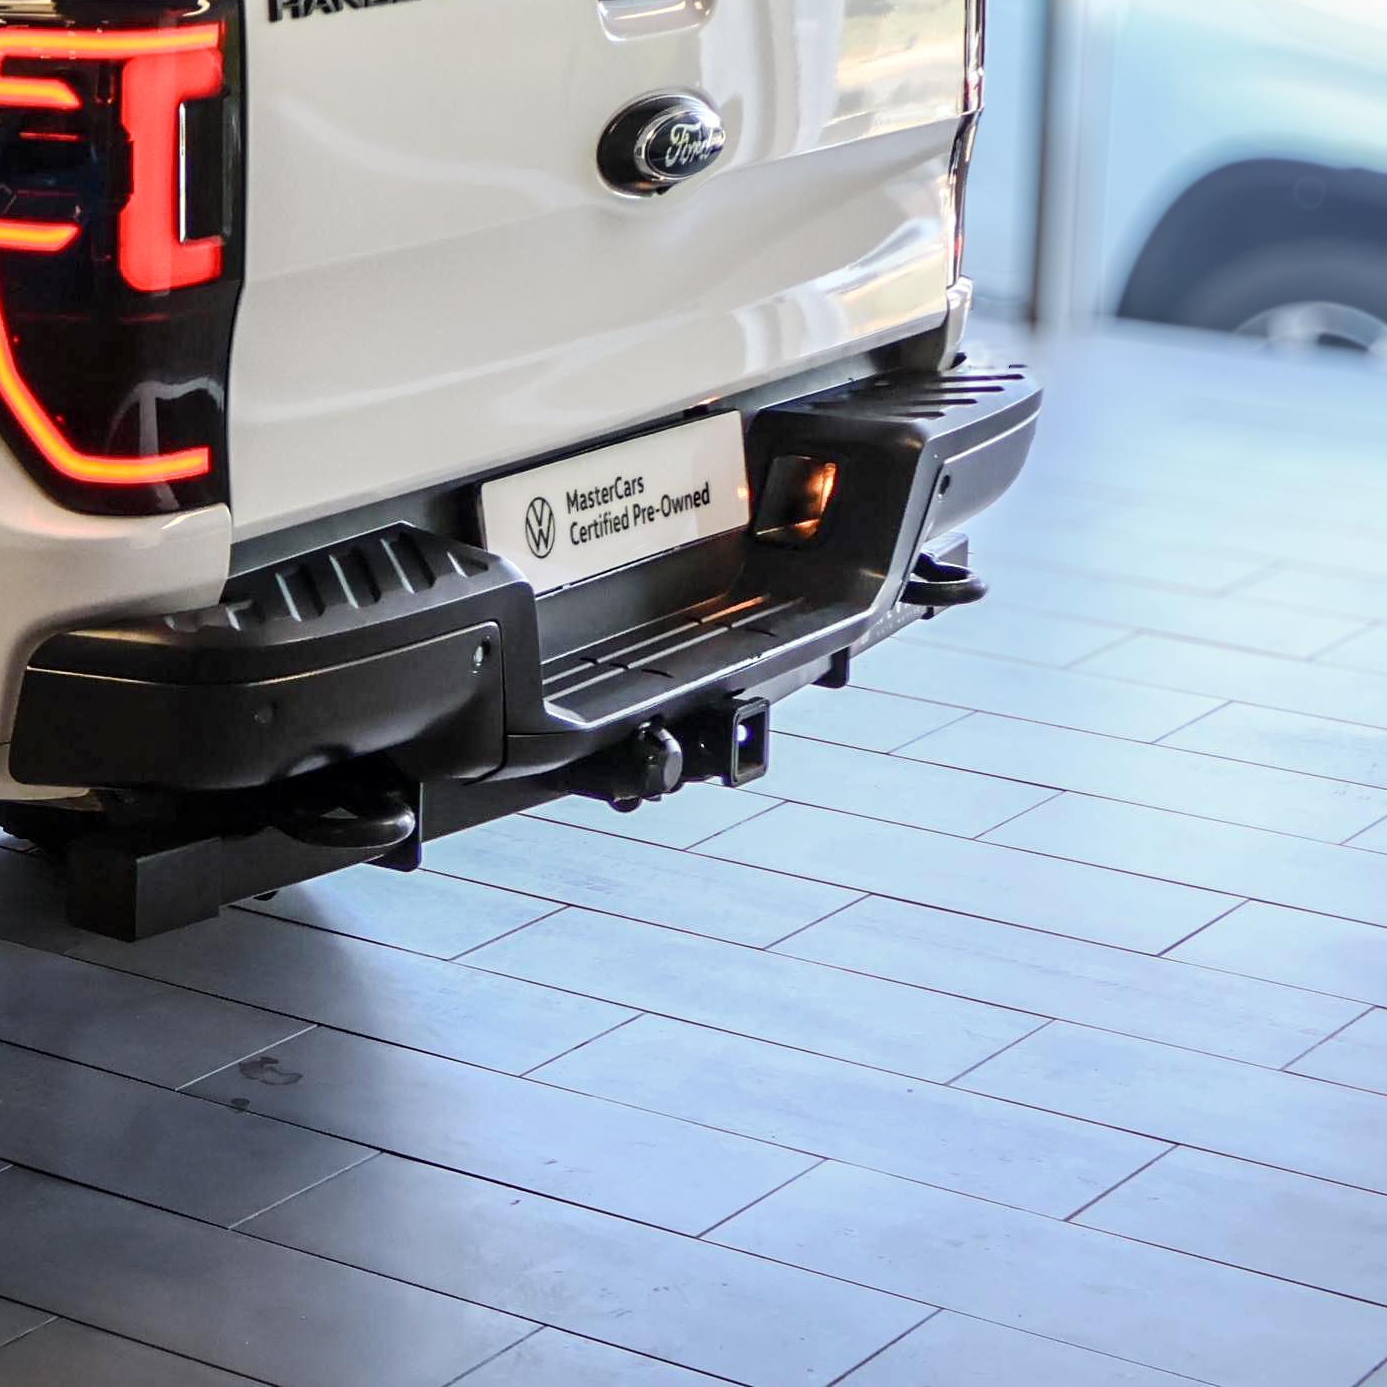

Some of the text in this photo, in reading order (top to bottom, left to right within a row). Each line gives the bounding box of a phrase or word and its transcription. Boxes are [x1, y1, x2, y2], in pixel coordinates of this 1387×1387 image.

[665, 122, 714, 167] Ford
[565, 476, 645, 515] MasterCars
[569, 481, 711, 546] Certified Pre-Owned
